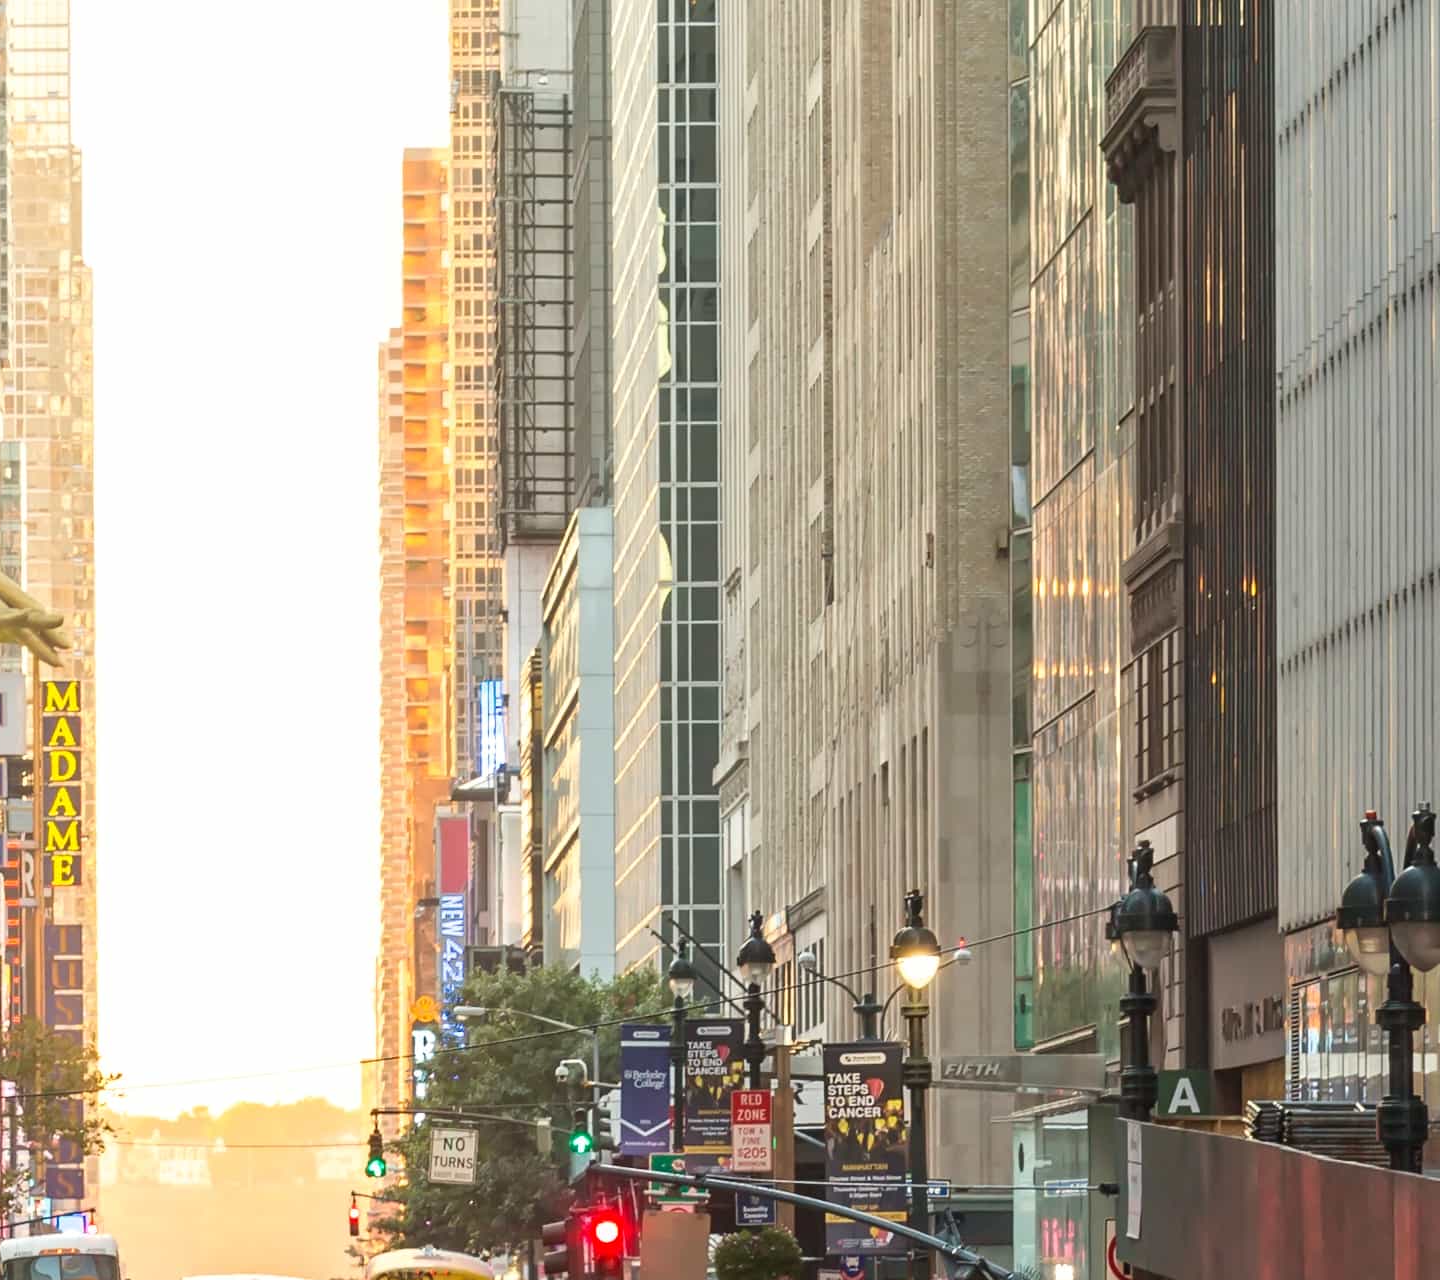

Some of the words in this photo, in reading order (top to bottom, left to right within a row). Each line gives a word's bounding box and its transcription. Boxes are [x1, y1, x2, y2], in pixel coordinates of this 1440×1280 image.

[42, 681, 82, 887] MADAME
[440, 895, 464, 937] NEW
[687, 1041, 712, 1049] TAKE
[687, 1050, 718, 1058] STEPS
[688, 1058, 700, 1066] TO
[702, 1058, 723, 1066] END
[632, 1069, 667, 1081] Berkeley
[687, 1066, 728, 1075] CANCER
[944, 1062, 1000, 1076] FIFTH
[634, 1079, 665, 1090] College
[827, 1074, 861, 1085] TAKE
[827, 1084, 869, 1096] STEPS
[1168, 1077, 1200, 1113] A
[740, 1093, 763, 1106] RED
[828, 1095, 846, 1107] TO
[849, 1095, 876, 1107] END
[736, 1110, 767, 1121] ZONE
[828, 1107, 882, 1119] CANCER
[443, 1137, 466, 1152] NO
[432, 1155, 473, 1169] TURNS
